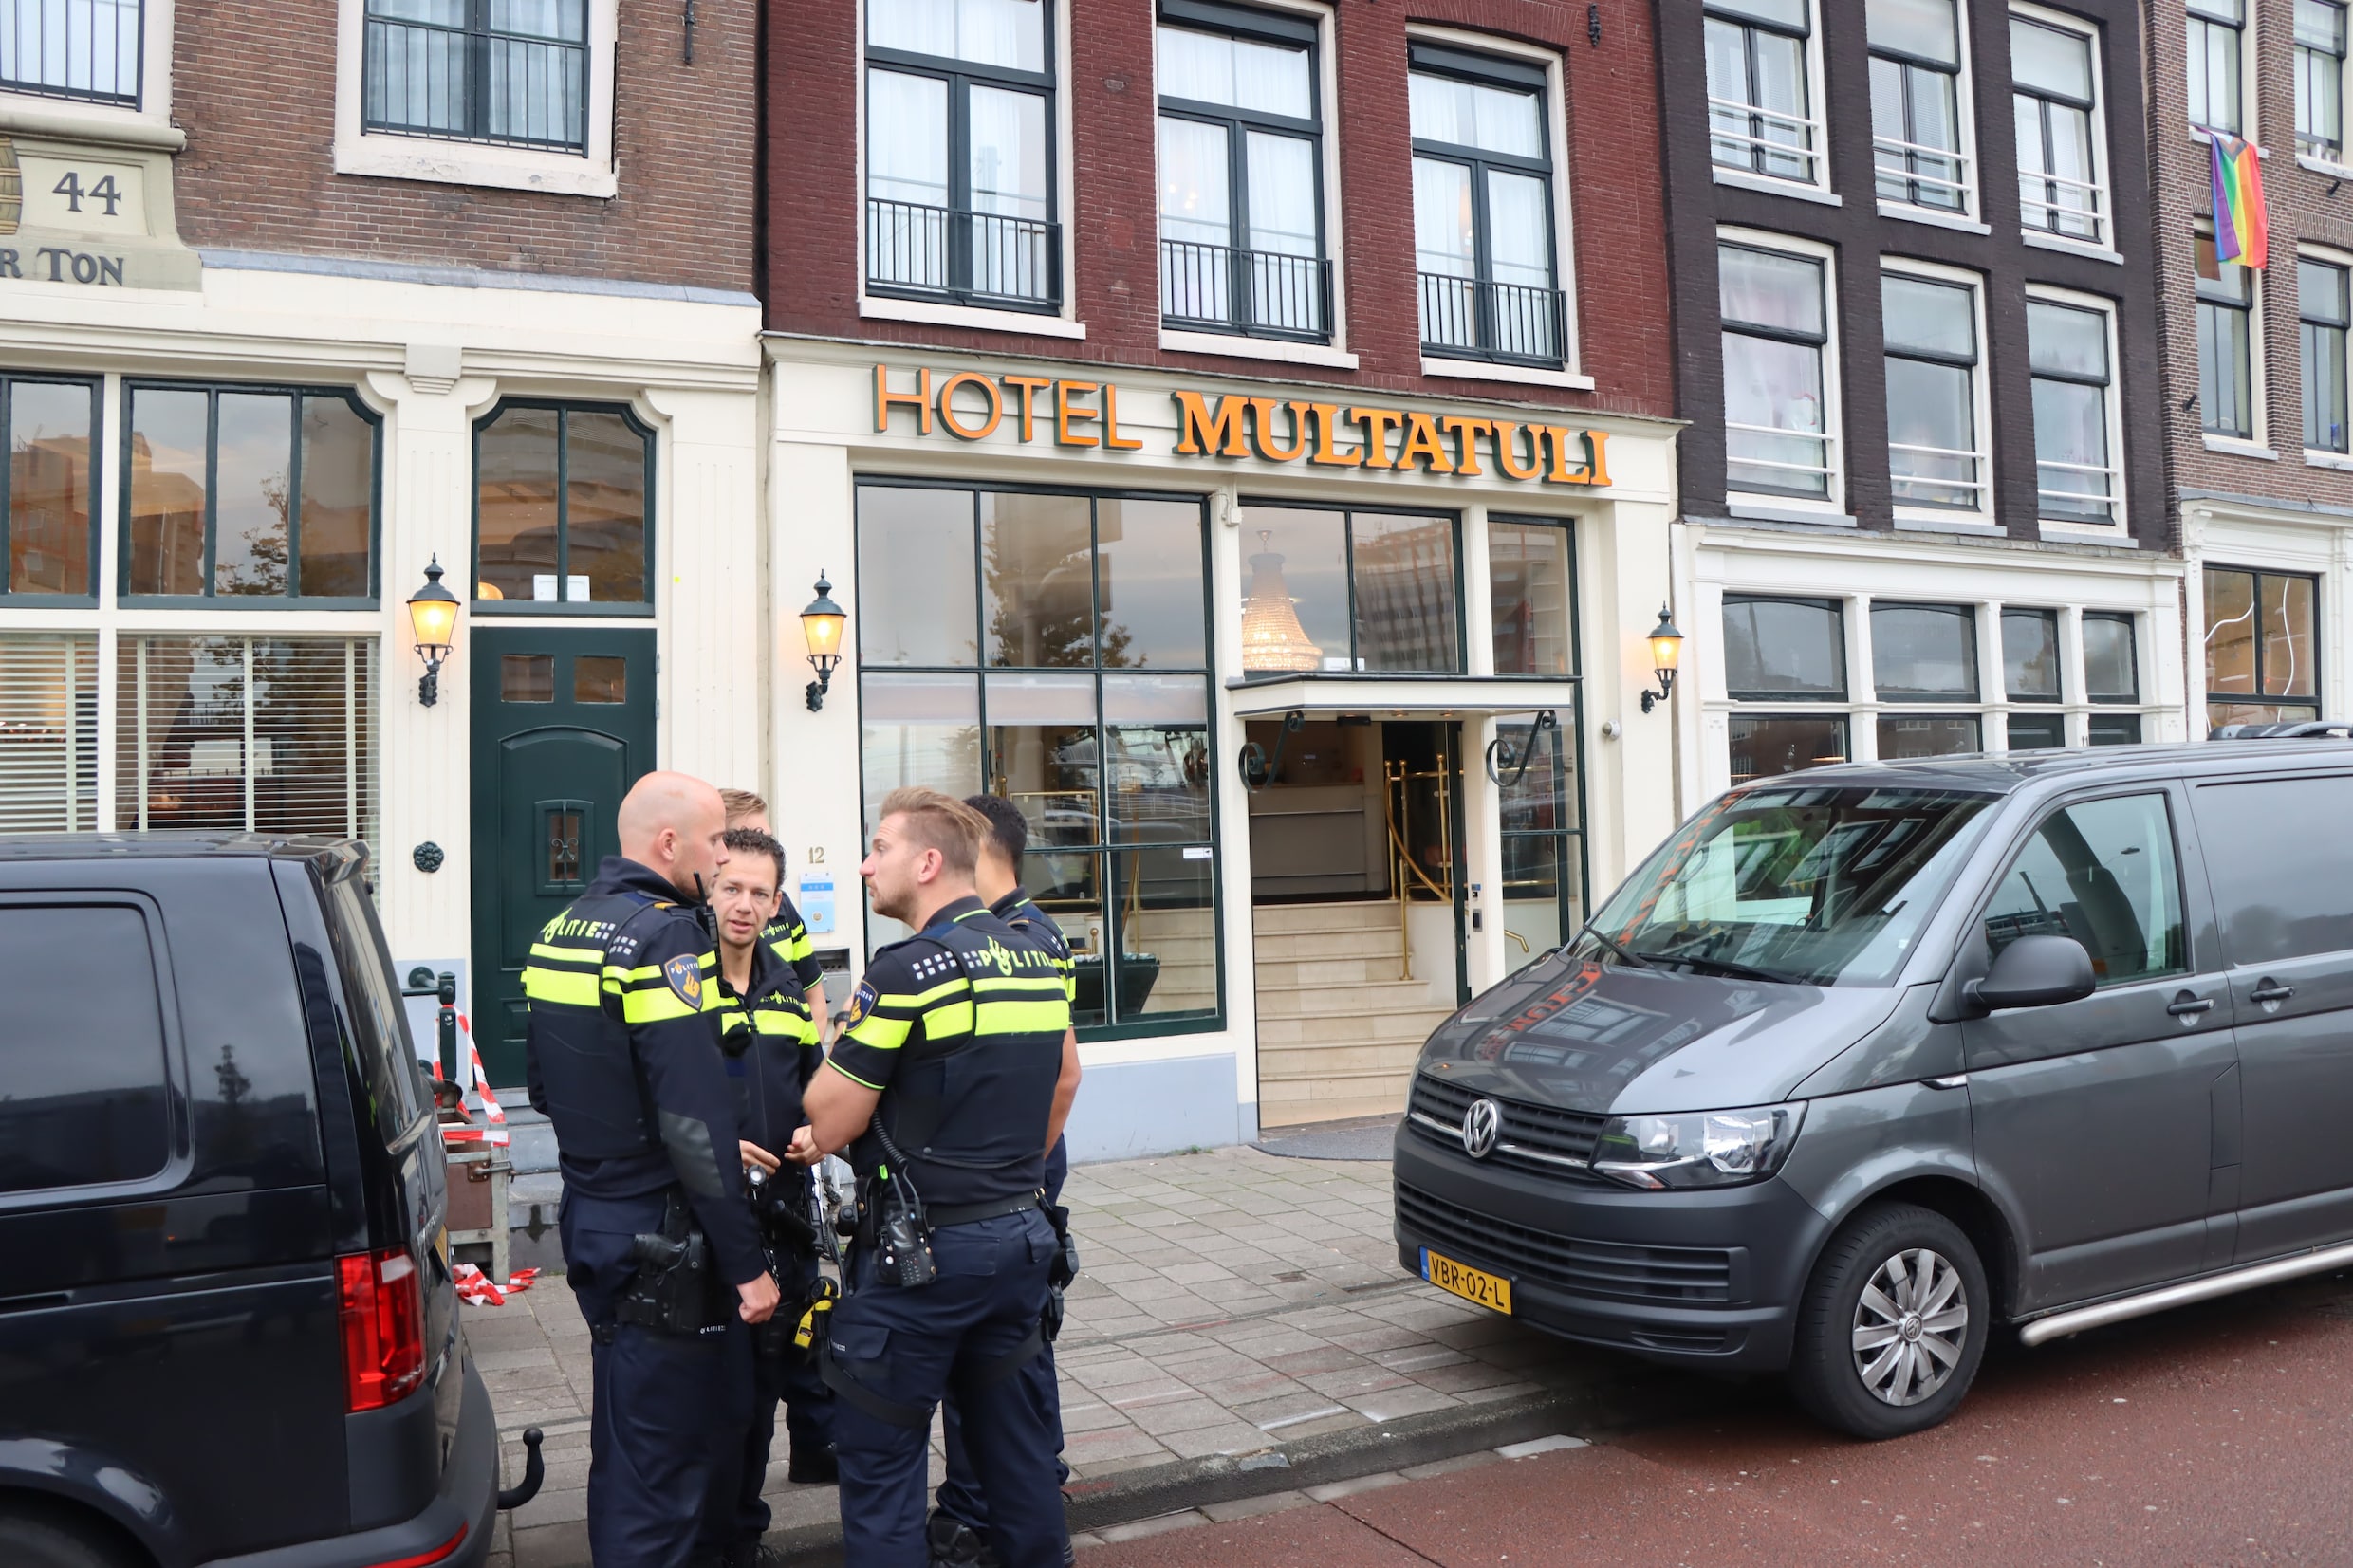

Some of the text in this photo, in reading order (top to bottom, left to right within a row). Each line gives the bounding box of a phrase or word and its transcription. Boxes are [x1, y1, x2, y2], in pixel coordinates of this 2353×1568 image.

[52, 172, 121, 216] 44
[36, 247, 124, 286] TON
[872, 364, 1613, 487] HOTEL MULTATULI
[808, 846, 825, 864] 12
[1431, 1256, 1505, 1307] VBR-02-L
